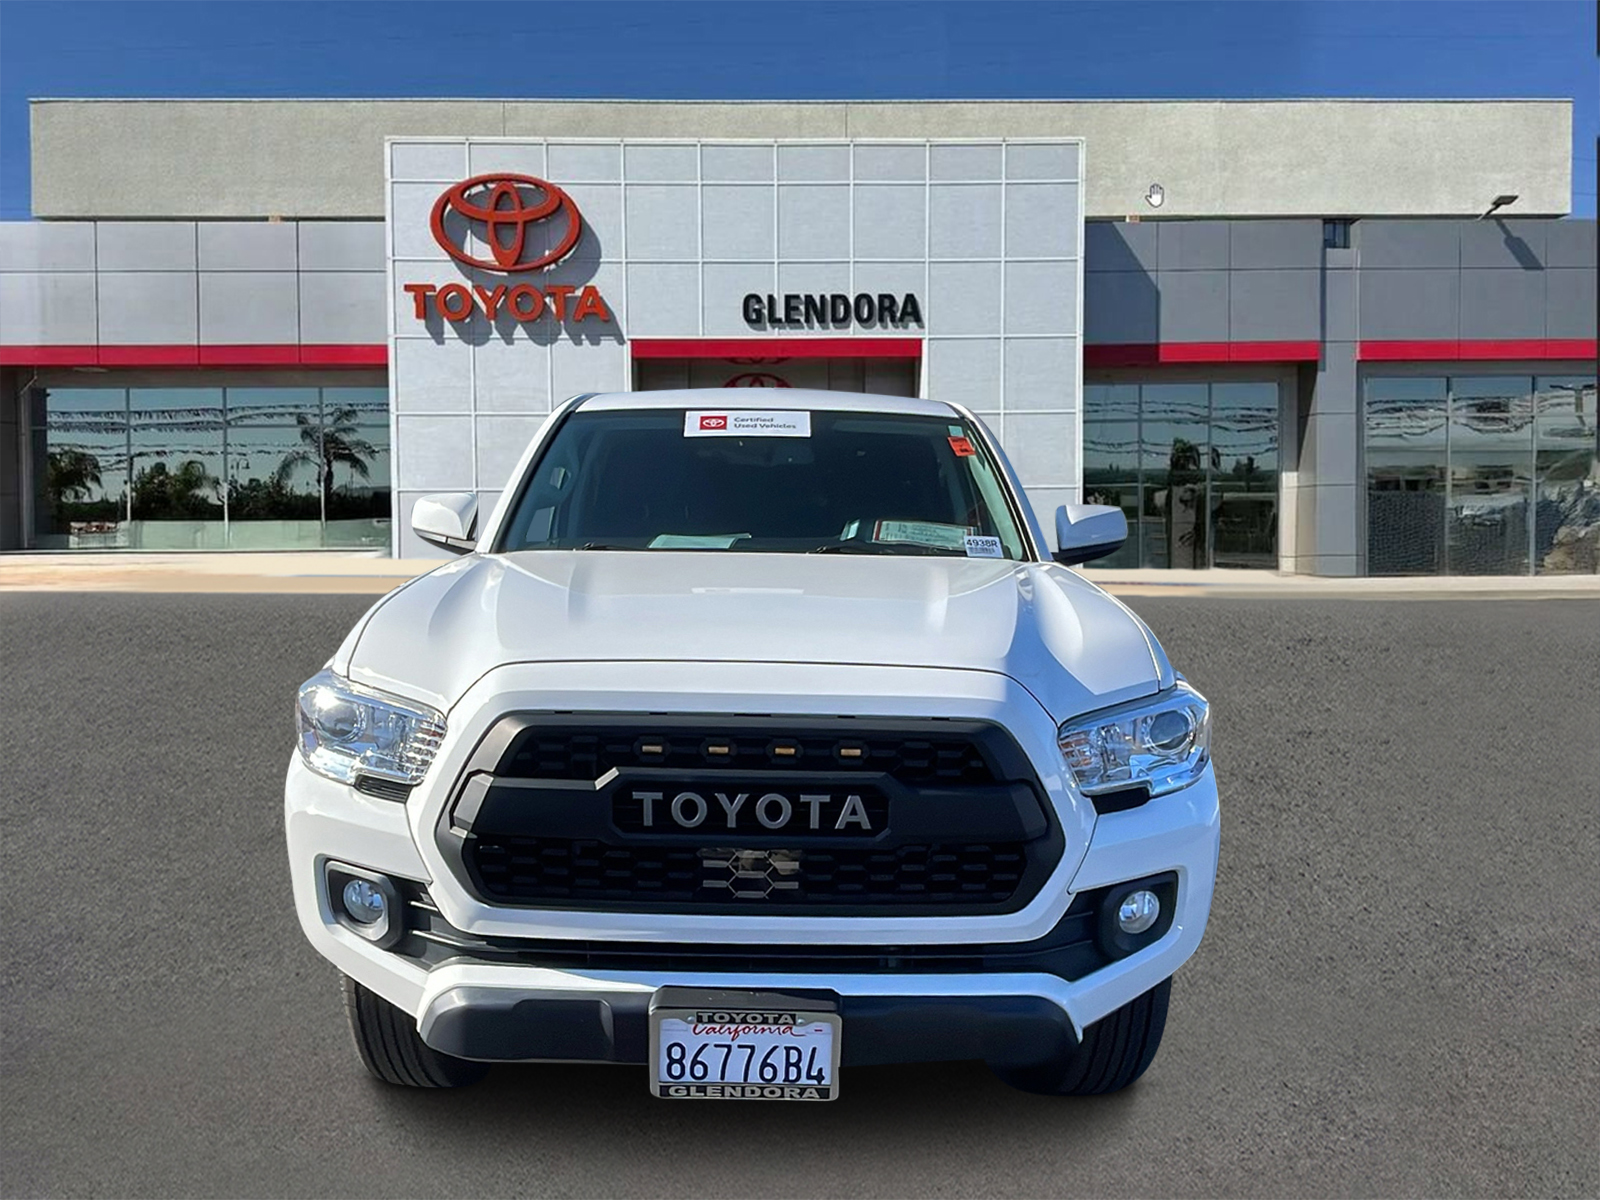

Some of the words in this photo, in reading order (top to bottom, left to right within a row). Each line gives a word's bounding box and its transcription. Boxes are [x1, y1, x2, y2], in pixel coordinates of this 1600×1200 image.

[404, 283, 610, 322] TOYOTA
[743, 292, 924, 325] GLENDORA
[966, 538, 998, 548] 4938R
[632, 791, 872, 830] TOYOTA
[698, 1012, 794, 1024] TOYOTA
[692, 1024, 806, 1042] California
[666, 1042, 826, 1085] 86776B4
[668, 1085, 820, 1099] GLENDORA
